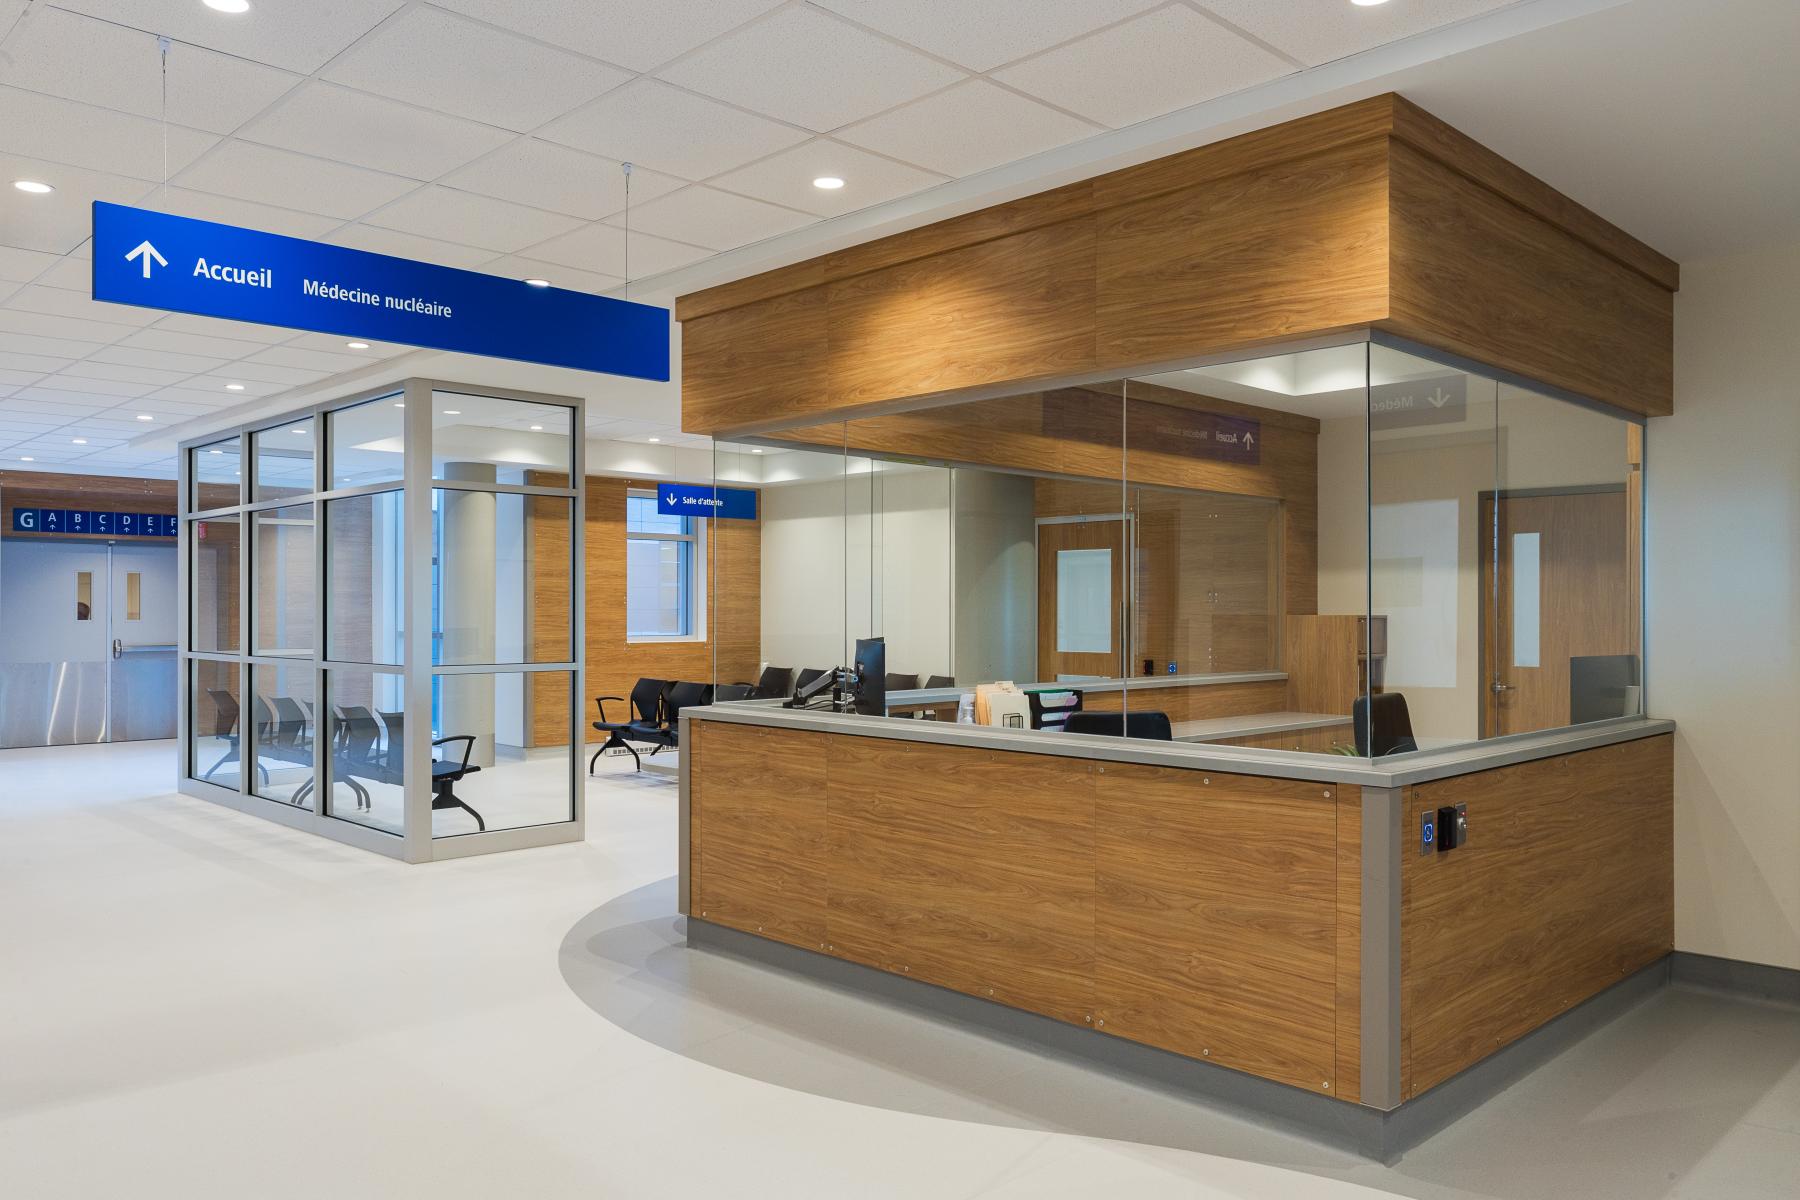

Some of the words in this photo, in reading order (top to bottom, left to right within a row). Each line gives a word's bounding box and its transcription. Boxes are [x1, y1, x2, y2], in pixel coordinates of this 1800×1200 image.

[193, 257, 272, 289] Accueil
[303, 279, 380, 306] Médecine
[385, 296, 452, 318] nucléaire
[682, 496, 697, 505] Salle
[20, 512, 34, 528] G
[48, 512, 57, 522] A
[74, 513, 82, 523] B
[99, 514, 107, 524] C
[123, 515, 131, 525] D
[147, 516, 153, 526] E
[170, 517, 177, 527] F
